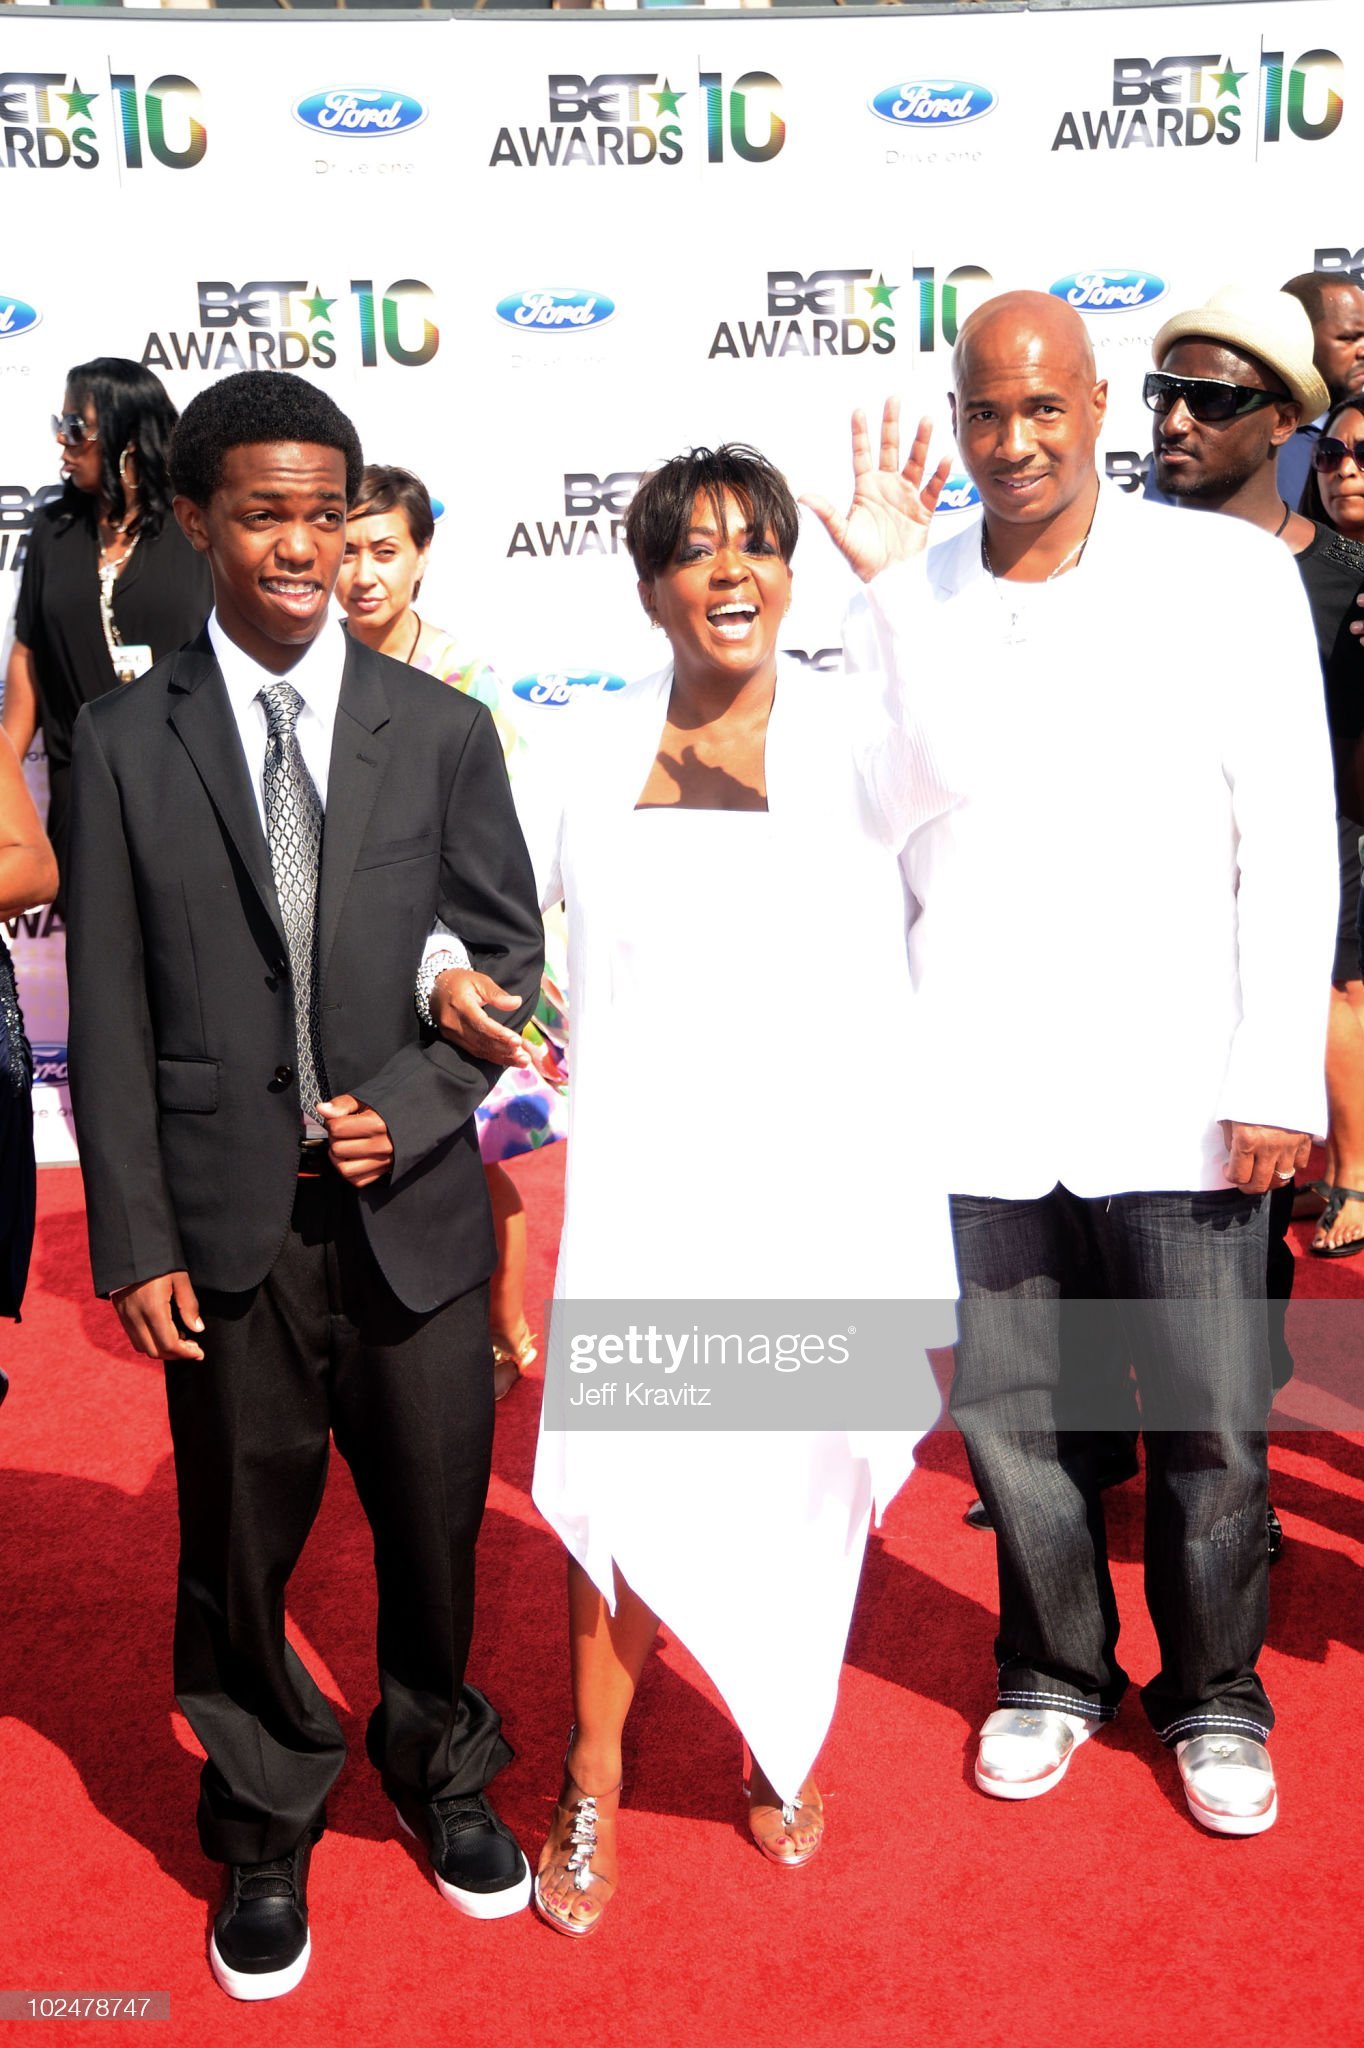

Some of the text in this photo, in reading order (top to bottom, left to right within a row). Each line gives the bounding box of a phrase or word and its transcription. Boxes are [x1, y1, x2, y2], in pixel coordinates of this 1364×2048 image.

[0, 72, 67, 124] ET
[548, 73, 658, 123] BET
[891, 83, 975, 119] Ford
[1112, 54, 1222, 106] BET
[1260, 48, 1344, 141] 10
[110, 73, 208, 169] 10
[317, 91, 402, 129] Ford
[699, 70, 786, 163] 10
[1050, 104, 1242, 151] AWARDS
[488, 124, 683, 167] AWARDS
[197, 281, 308, 328] BET
[514, 289, 598, 325] Ford
[767, 269, 873, 317] BET
[912, 264, 994, 352] 10
[1067, 271, 1145, 306] Ford
[350, 278, 440, 367] 10
[708, 316, 896, 359] AWARDS
[141, 330, 337, 371] AWARDS
[564, 472, 642, 516] BE
[506, 519, 630, 558] AWAR
